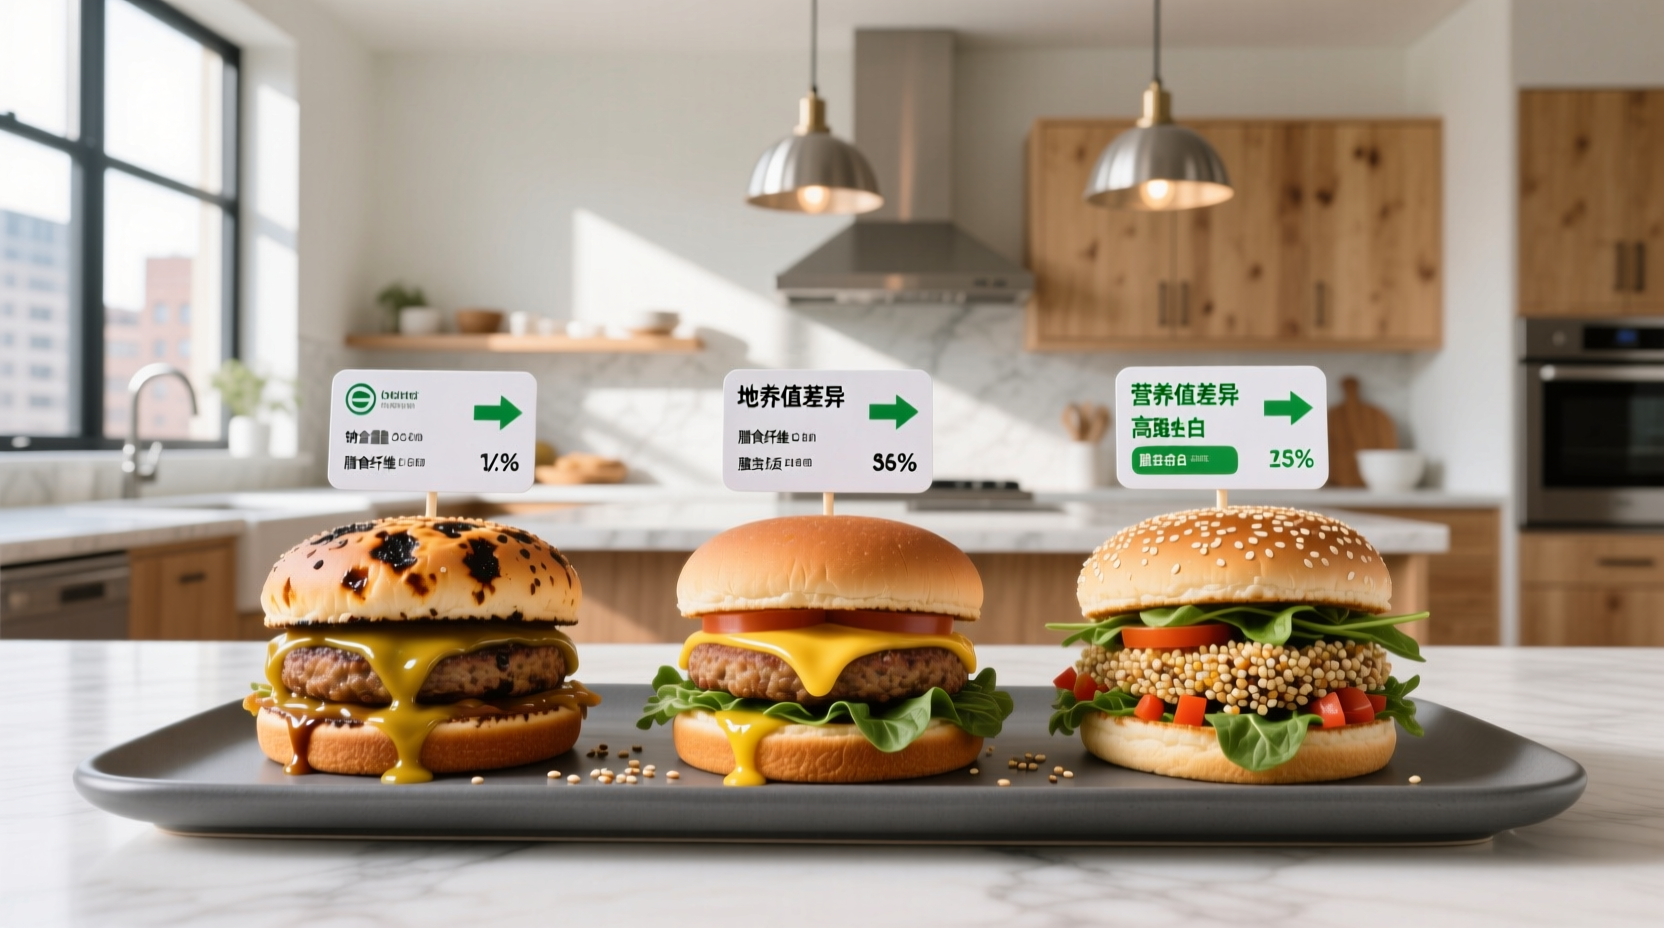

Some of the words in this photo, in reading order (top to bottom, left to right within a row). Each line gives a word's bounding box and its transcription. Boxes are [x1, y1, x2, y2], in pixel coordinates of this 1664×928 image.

[1131, 382, 1239, 407] 营养值差异
